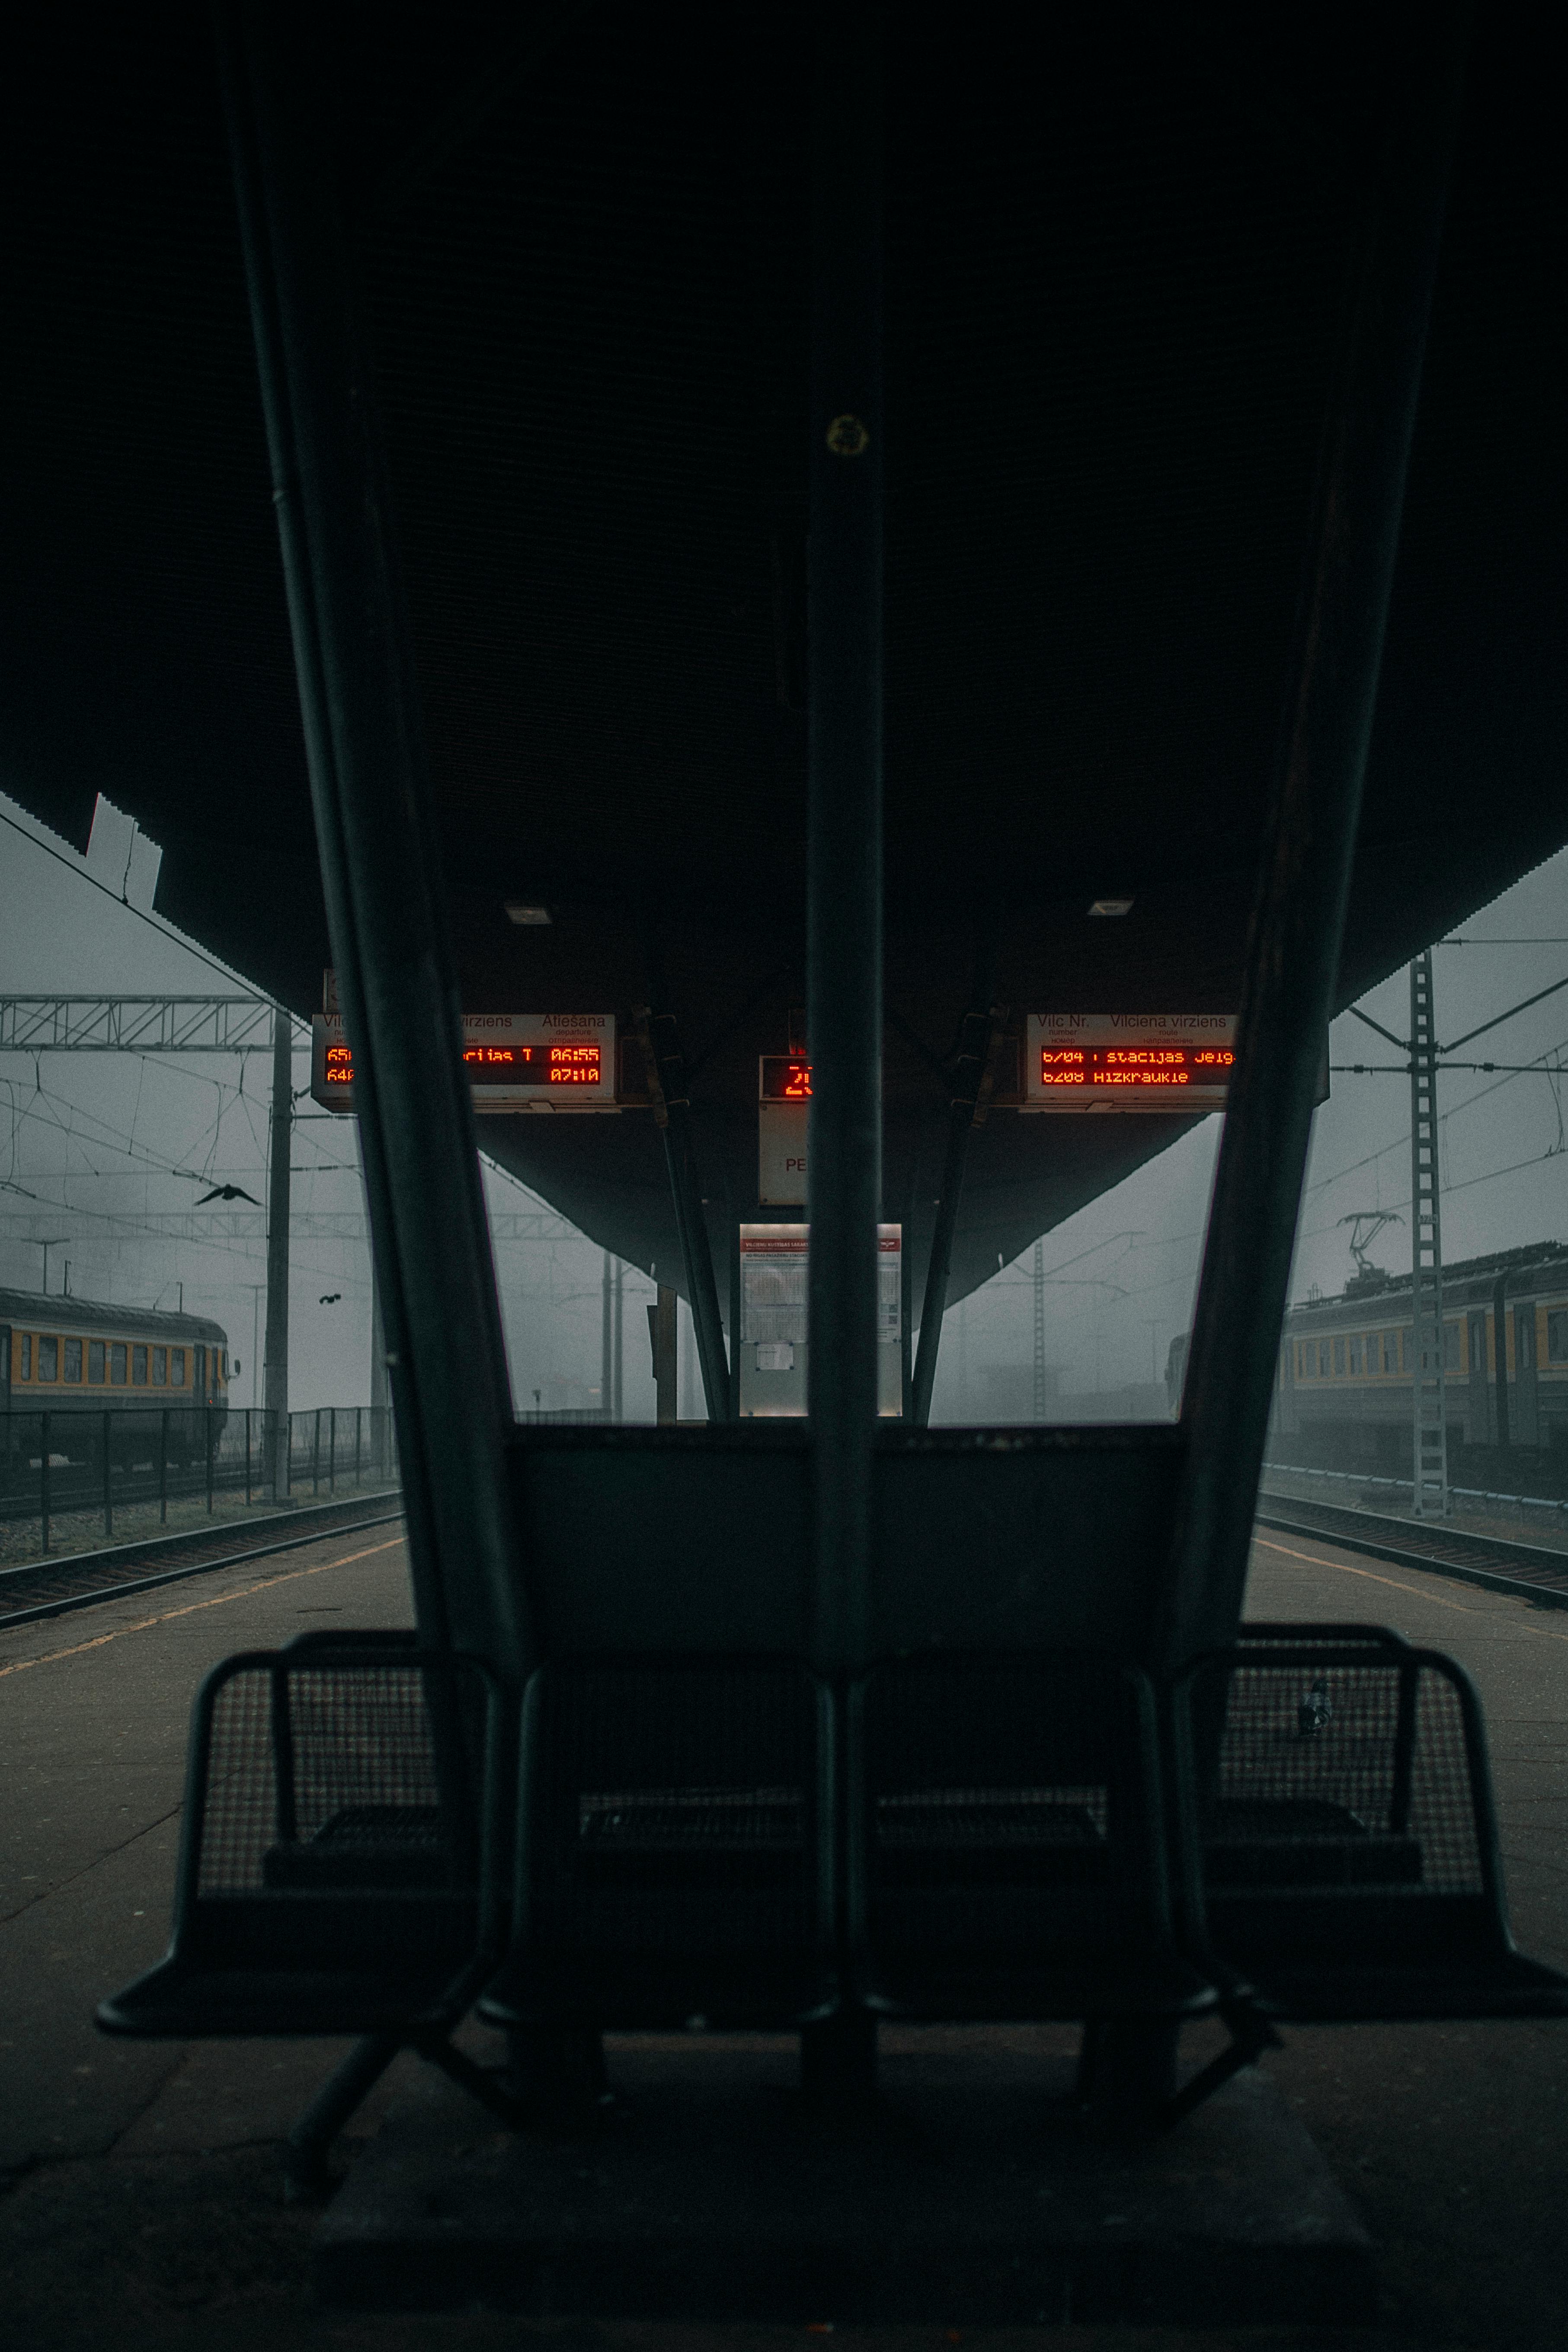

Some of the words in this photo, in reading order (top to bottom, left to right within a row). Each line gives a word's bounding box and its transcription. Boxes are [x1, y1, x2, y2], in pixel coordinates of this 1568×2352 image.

[542, 1014, 605, 1027] Atiešana
[1038, 1014, 1064, 1027] Vilc
[1070, 1014, 1089, 1027] Nr.
[1110, 1014, 1166, 1027] Vilciena
[1171, 1014, 1226, 1027] virziens
[551, 1048, 599, 1061] 06:55
[1194, 1052, 1237, 1065] Jelg
[551, 1068, 599, 1081] 07:10
[786, 1158, 807, 1171] PE
